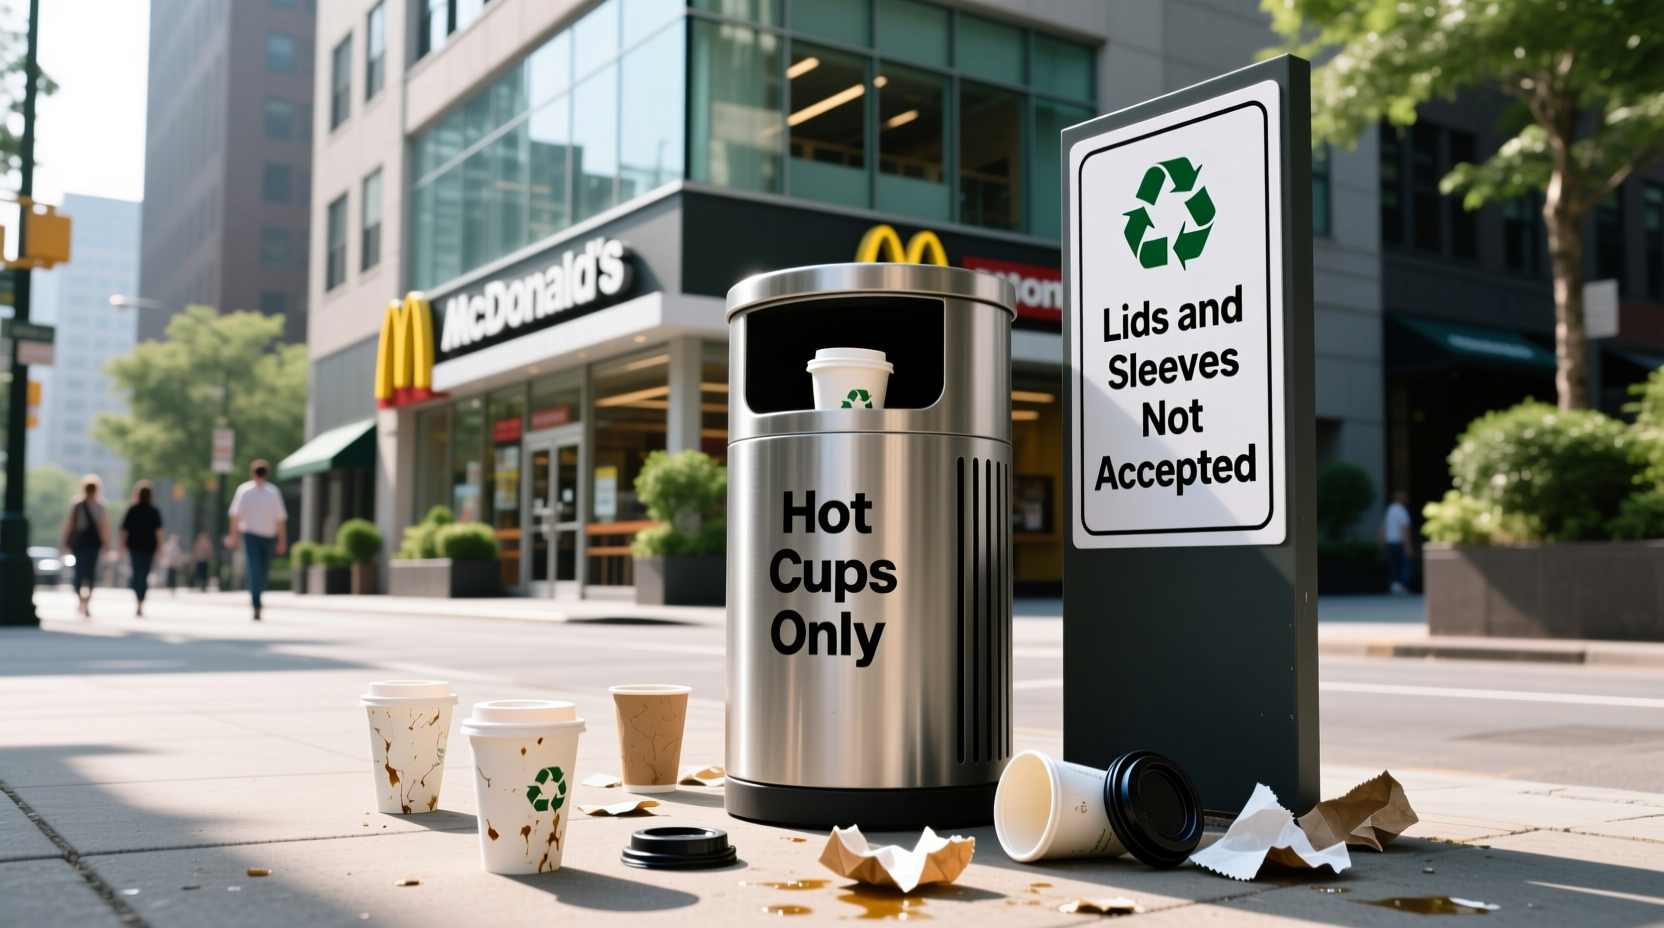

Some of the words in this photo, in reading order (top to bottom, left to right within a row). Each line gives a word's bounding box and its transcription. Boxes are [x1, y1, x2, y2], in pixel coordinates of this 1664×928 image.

[440, 237, 625, 352] McDonald's
[1103, 301, 1169, 342] Lids
[1177, 285, 1243, 331] and
[1108, 349, 1240, 390] Sleeves
[1142, 399, 1204, 438] Not
[1094, 444, 1257, 496] Accepted
[782, 490, 873, 534] Hot
[769, 548, 898, 603] Cups
[770, 609, 886, 668] Only
